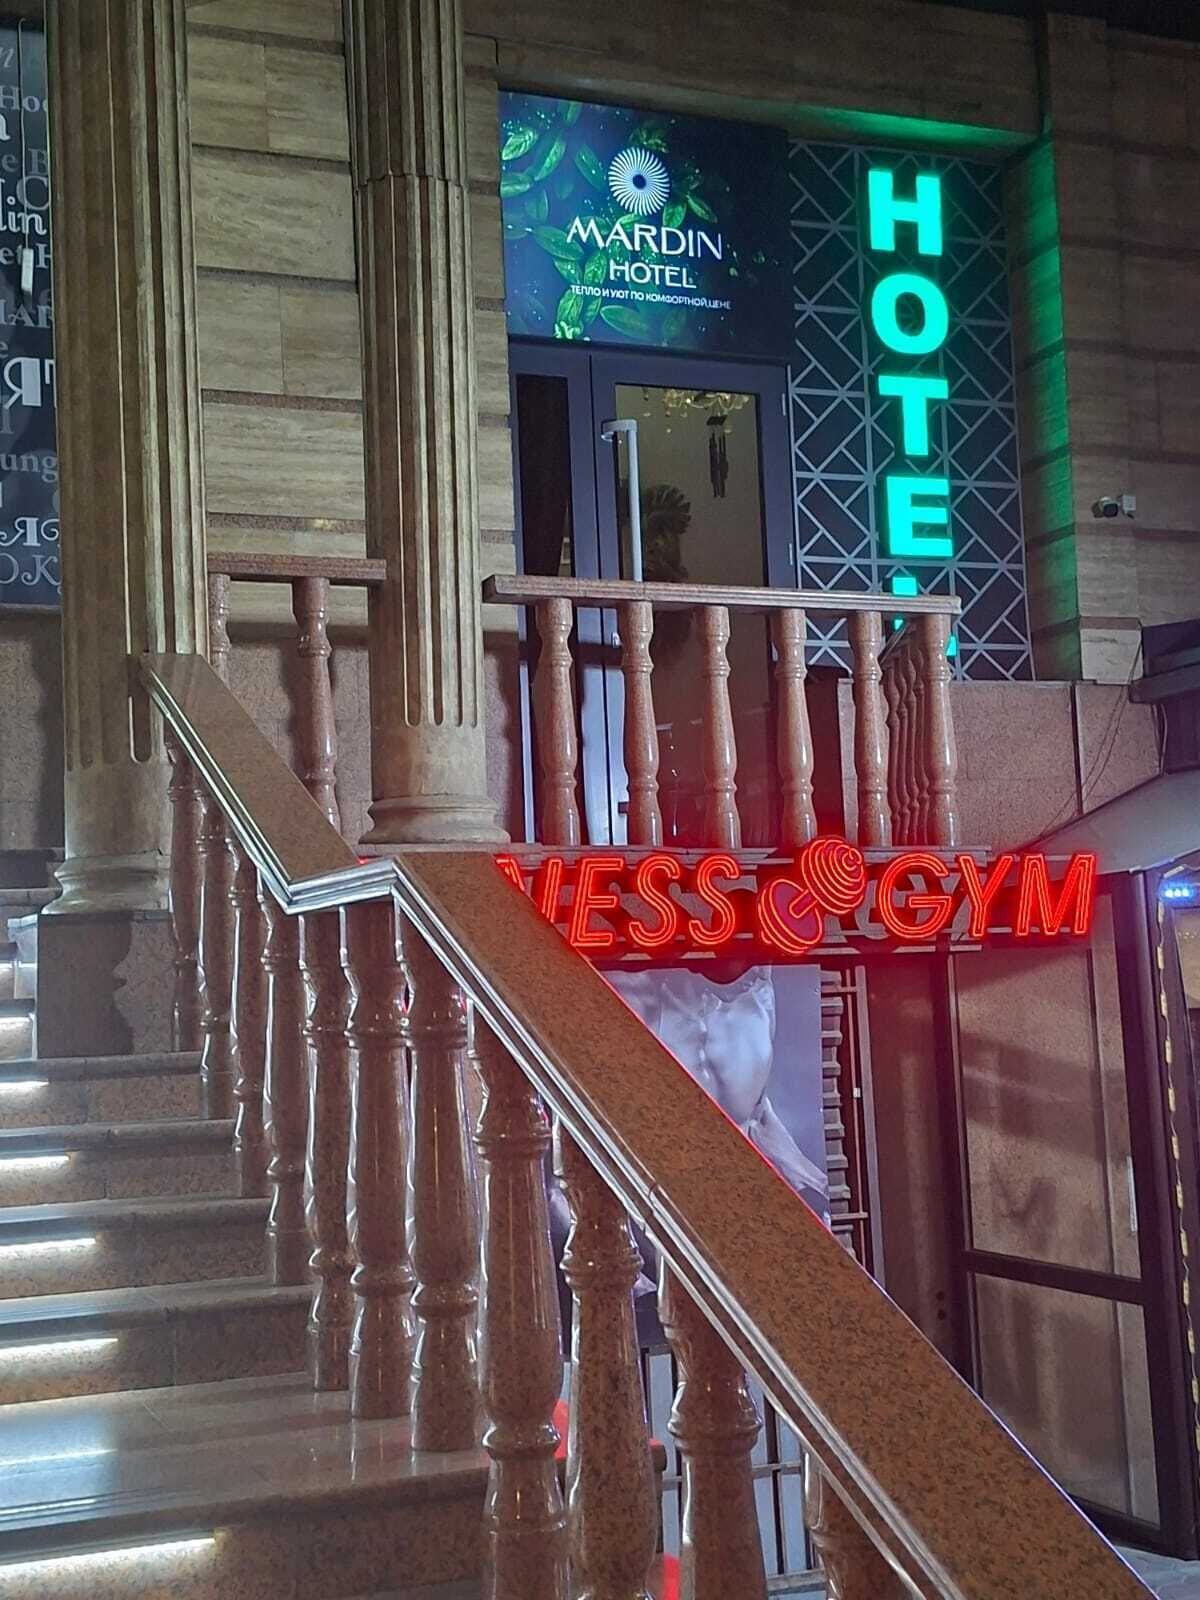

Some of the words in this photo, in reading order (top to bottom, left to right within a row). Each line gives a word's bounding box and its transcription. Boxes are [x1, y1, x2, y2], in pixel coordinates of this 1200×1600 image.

[566, 215, 723, 261] MARDIN
[609, 258, 697, 289] HOTEL
[570, 284, 601, 297] ТЕПЛО
[602, 287, 610, 298] И
[610, 288, 629, 300] УЮТ
[630, 290, 645, 301] ПО
[645, 292, 707, 307] КОМФОРТНОЙ
[879, 852, 1096, 939] GYM
